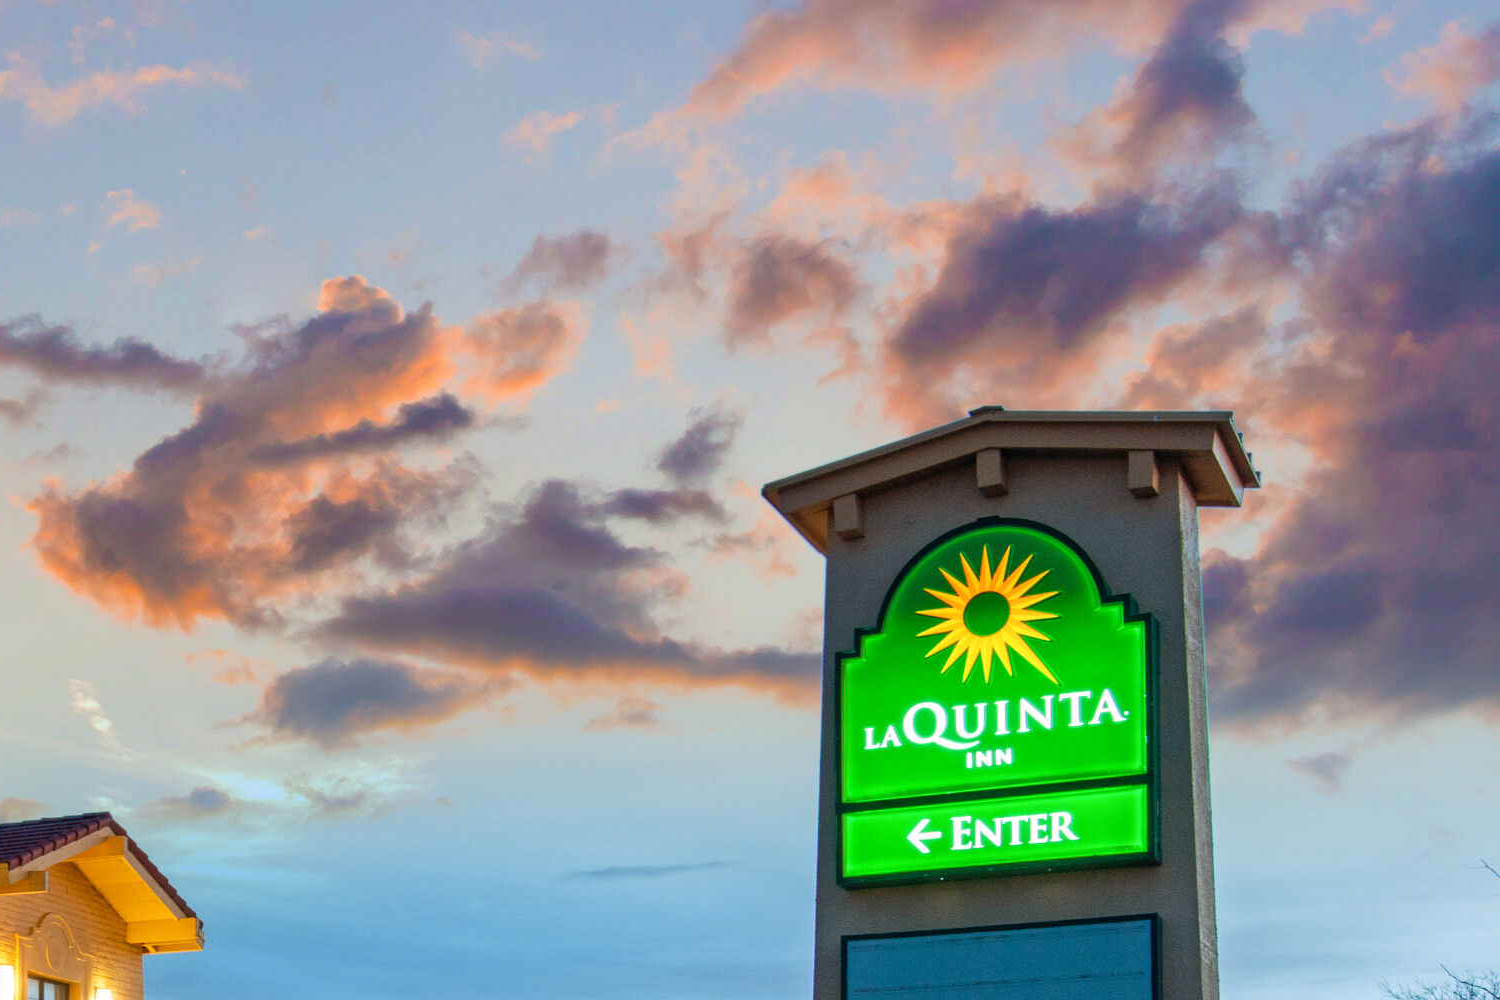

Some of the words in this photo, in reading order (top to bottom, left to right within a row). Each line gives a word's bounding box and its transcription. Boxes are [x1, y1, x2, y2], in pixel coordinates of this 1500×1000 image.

[864, 724, 903, 750] LA
[903, 688, 1128, 750] QUINTA
[966, 747, 1013, 769] INN
[950, 811, 1080, 851] ENTER
